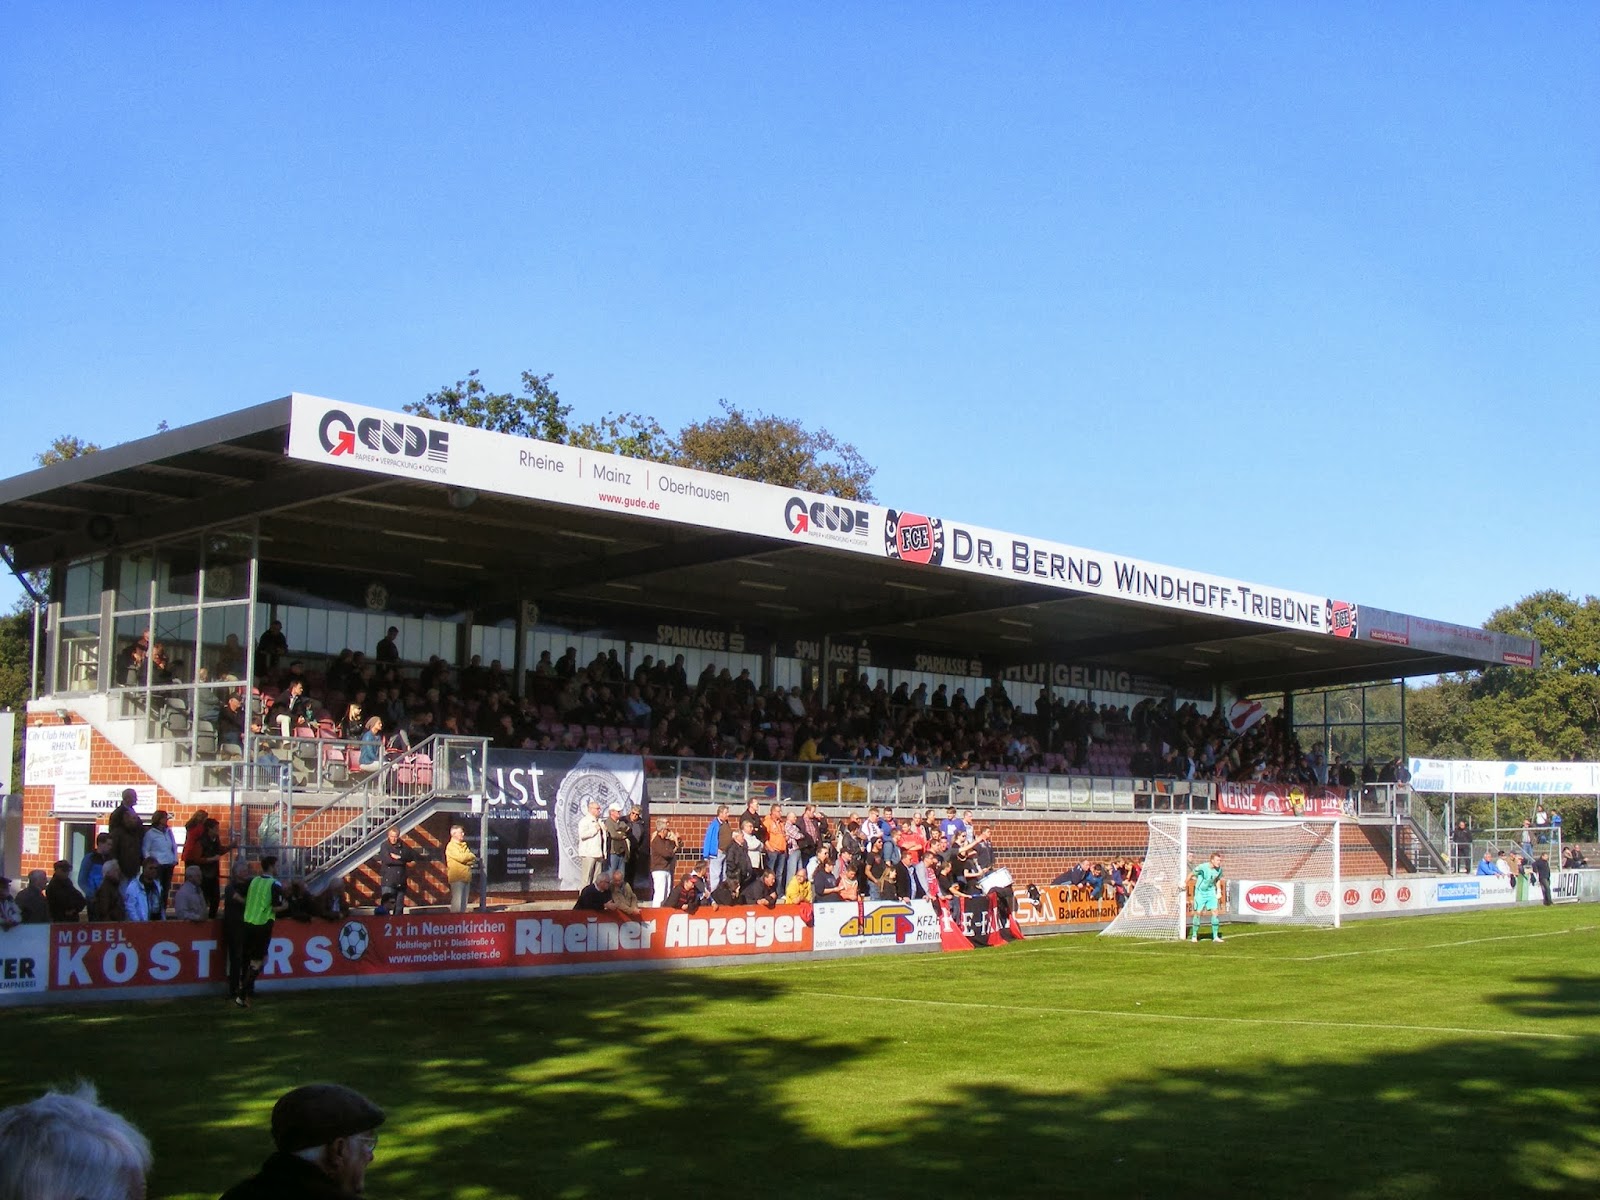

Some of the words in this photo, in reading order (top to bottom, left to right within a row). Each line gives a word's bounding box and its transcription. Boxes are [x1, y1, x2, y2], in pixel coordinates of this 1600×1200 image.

[355, 452, 376, 463] PAPIER
[379, 457, 418, 470] VERPACKUNG
[422, 464, 447, 475] LOGISTIK
[519, 450, 565, 473] Rheine
[593, 464, 631, 485] Mainz
[658, 475, 730, 503] Oberhausen
[598, 492, 660, 511] www.gude.de
[901, 524, 930, 552] FCE
[656, 623, 726, 651] SPARKASSE
[794, 639, 855, 664] SPAASSE
[914, 654, 968, 677] SPARKASSE
[27, 731, 40, 741] City
[41, 730, 58, 740] Club
[59, 728, 77, 739] Hotel
[51, 741, 77, 751] RHEINE
[1503, 780, 1573, 792] HAUSMEIER
[91, 799, 122, 809] KORT
[1058, 889, 1083, 903] CARL
[1248, 892, 1286, 905] wenco
[1058, 905, 1119, 919] Baufachmarkt
[384, 923, 393, 936] 2
[396, 927, 403, 937] x
[406, 922, 418, 936] in
[422, 919, 506, 936] Neuenkirchen
[514, 916, 657, 955] Rheiner
[664, 911, 809, 948] Anzeiger
[916, 930, 940, 942] Rhein
[433, 939, 442, 948] 11
[815, 938, 837, 948] beraten
[57, 937, 334, 986] KÖSTRS
[388, 948, 501, 963] www.moebel-koesters.de
[0, 957, 36, 979] ER
